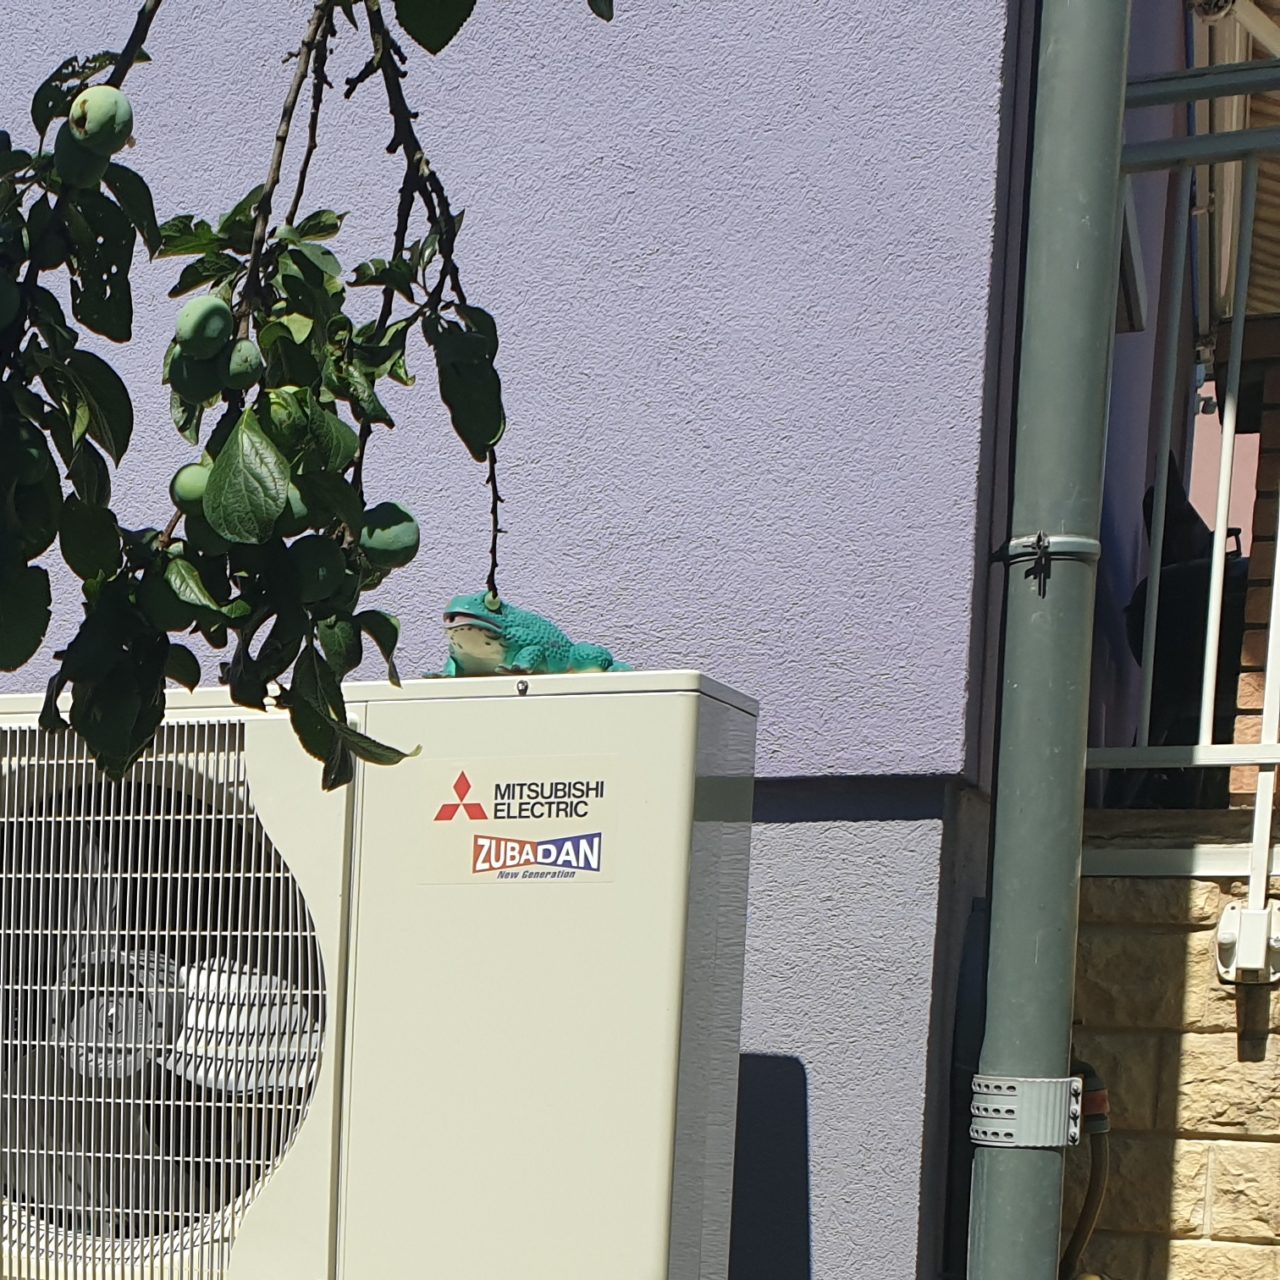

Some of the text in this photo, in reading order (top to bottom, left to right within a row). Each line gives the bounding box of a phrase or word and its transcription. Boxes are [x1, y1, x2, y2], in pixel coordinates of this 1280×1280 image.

[494, 780, 605, 801] MITSUBISHI
[493, 800, 589, 820] ELECTRIC
[475, 837, 600, 871] ZUBADAN
[497, 870, 576, 880] New Generation
